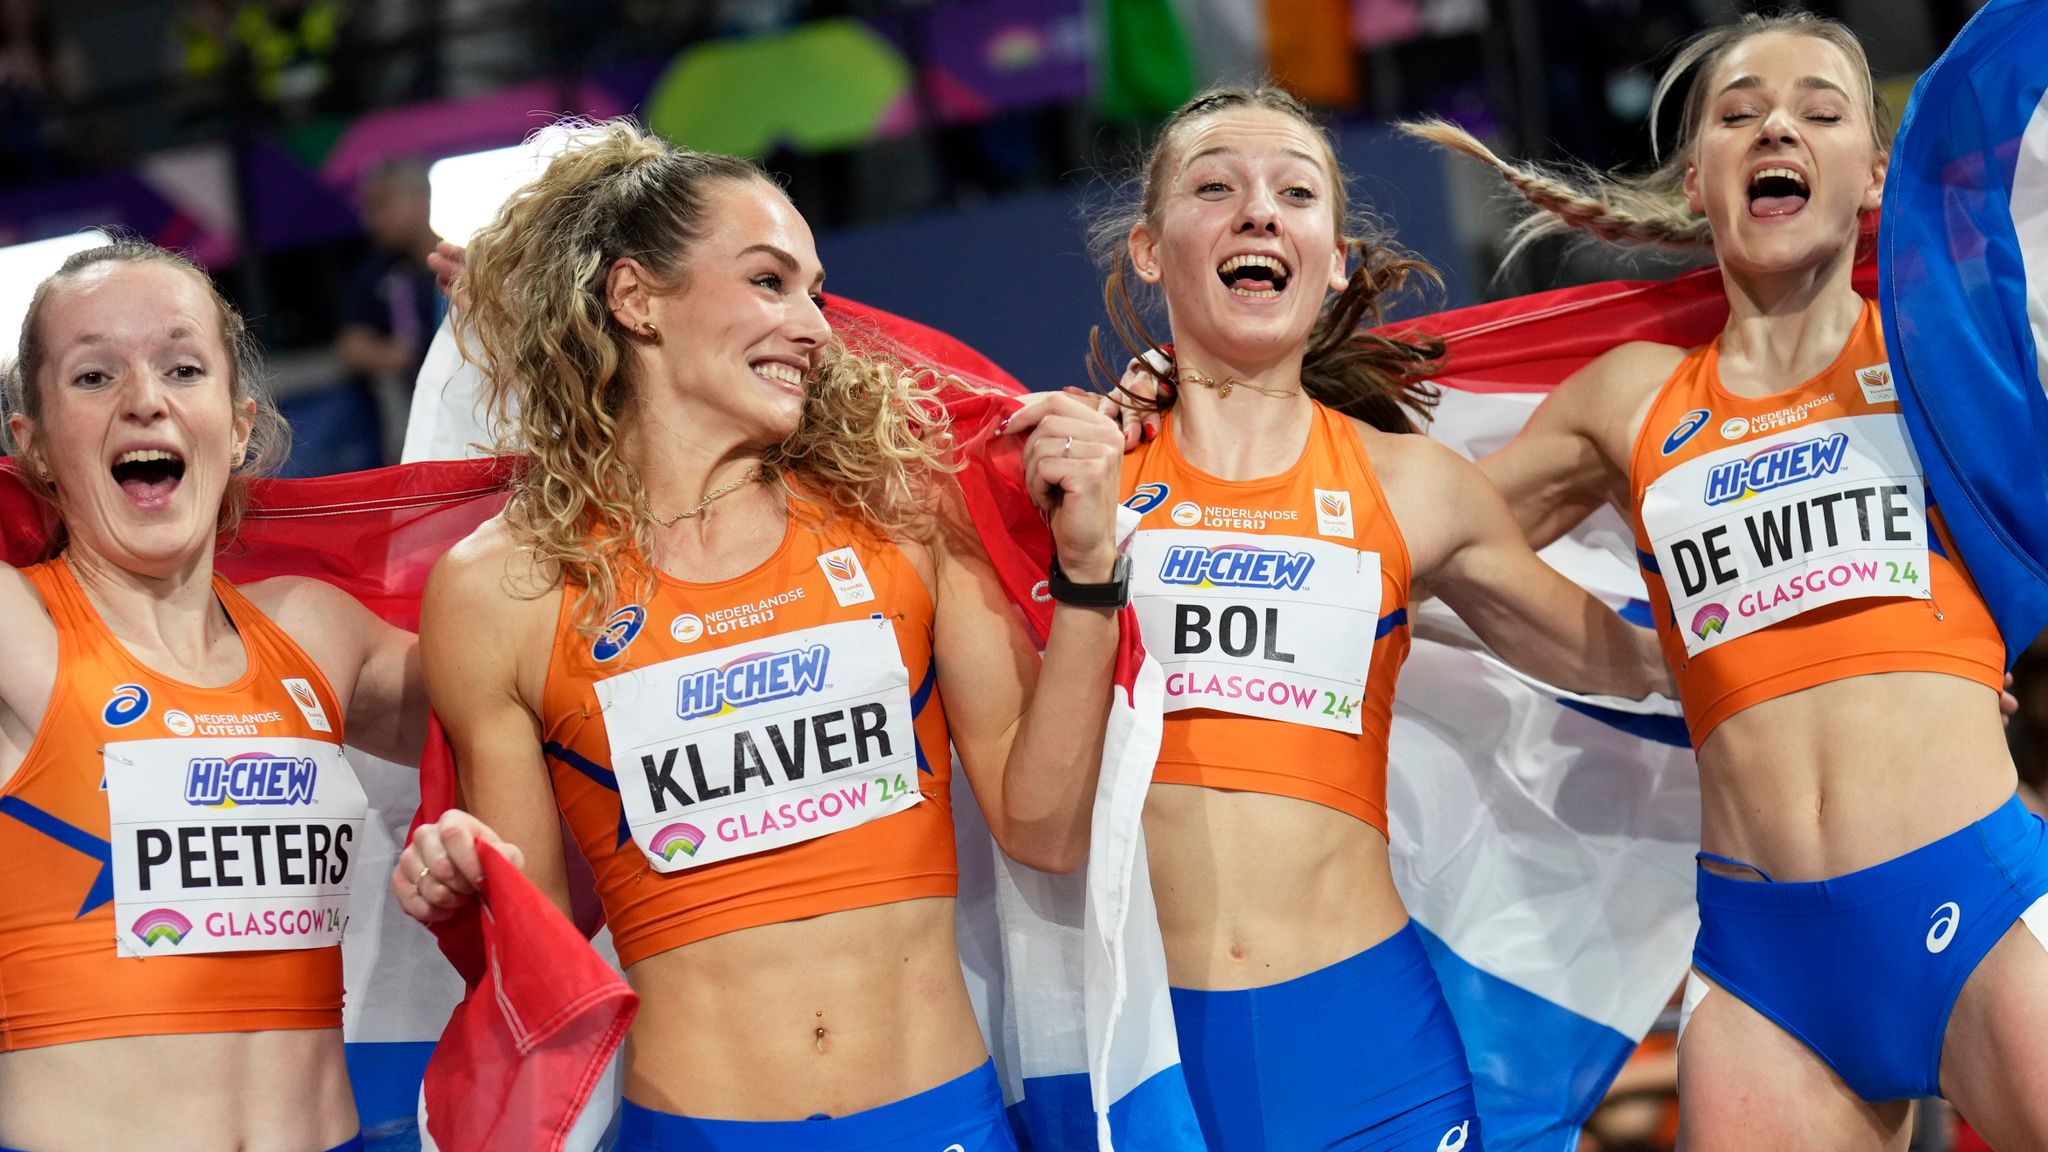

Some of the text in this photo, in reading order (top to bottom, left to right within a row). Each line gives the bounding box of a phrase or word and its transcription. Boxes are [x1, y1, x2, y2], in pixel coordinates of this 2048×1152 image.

[1751, 393, 1836, 424] NEDERLANDSE
[1751, 411, 1808, 434] LOTERIJ
[1704, 433, 1849, 506] HI-CHEW
[1204, 517, 1266, 530] LOTERIJ
[1205, 506, 1298, 521] NEDERLANDSE
[1670, 485, 1912, 598] DE WITTE
[1159, 546, 1315, 591] HI-CHEW
[1738, 561, 1919, 617] GLASGOW 24
[704, 588, 806, 623] NEDERLANDSE
[707, 609, 775, 635] LOTERIJ
[1174, 603, 1295, 664] BOL
[676, 644, 830, 720] HI-CHEW
[1166, 673, 1352, 718] GLASGOW 24
[194, 711, 283, 725] NEDERLANDSE
[197, 723, 258, 736] LOTERIJ
[641, 702, 893, 814] KLAVER
[184, 757, 317, 806] HI-CHEW
[716, 773, 908, 843] GLASGOW 24
[136, 824, 353, 891] PEETERS
[205, 907, 340, 937] GLASGOW 24
